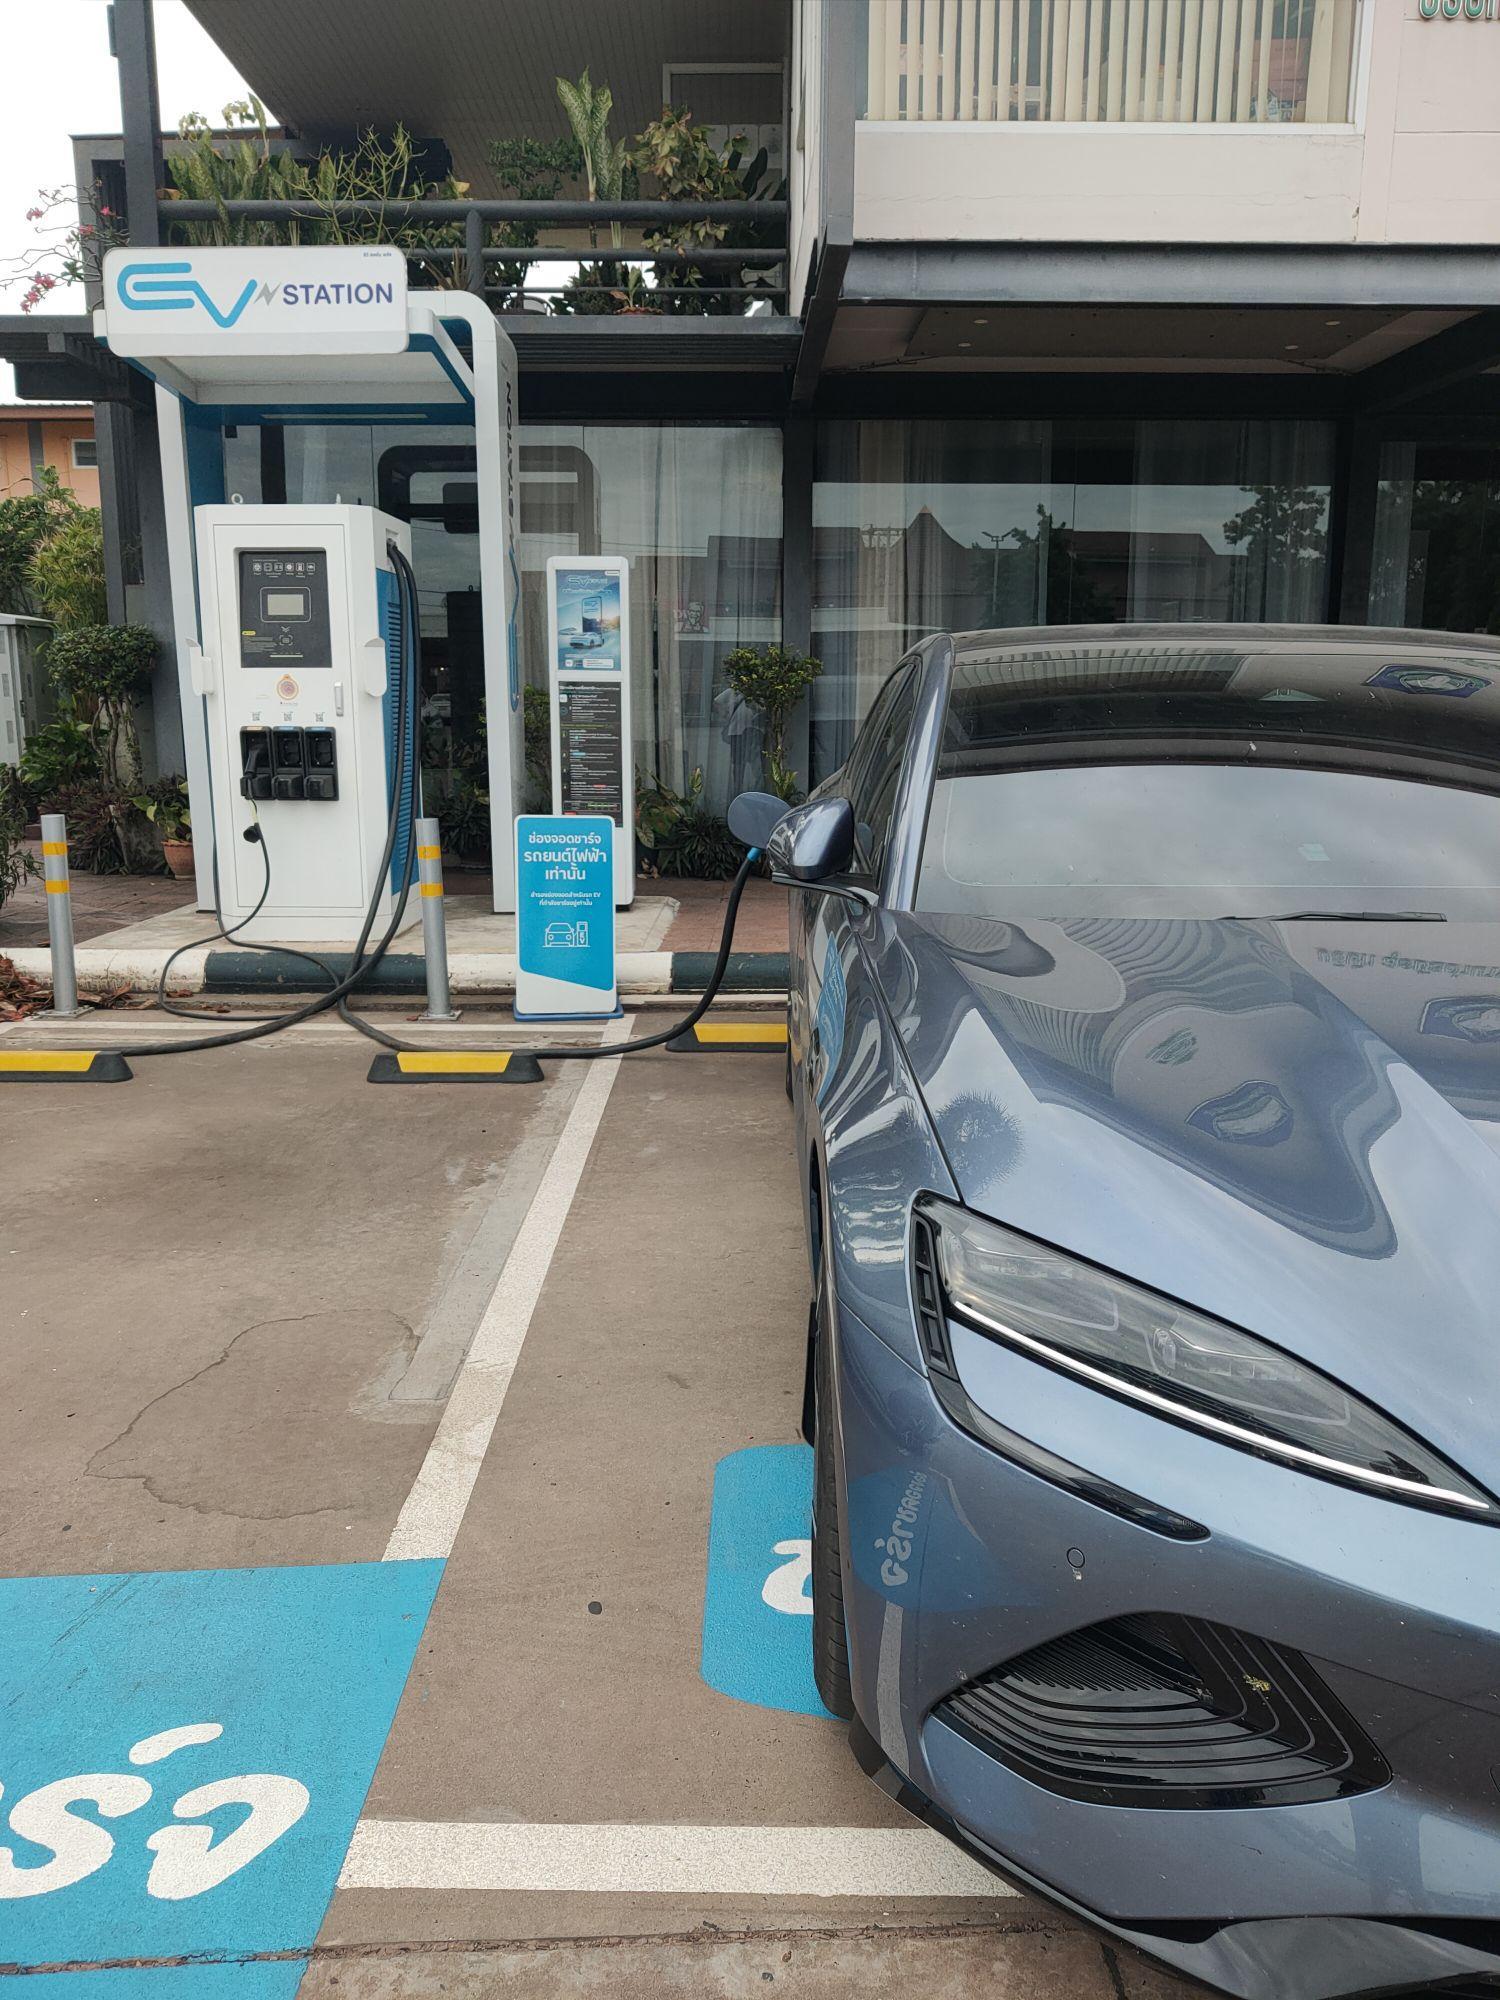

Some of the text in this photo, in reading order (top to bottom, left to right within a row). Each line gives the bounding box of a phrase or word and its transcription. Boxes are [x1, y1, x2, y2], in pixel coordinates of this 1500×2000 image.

[117, 262, 392, 328] EV STATION
[505, 381, 514, 518] STATION
[524, 847, 607, 863] รถยนต์ไฟฟ้า
[529, 832, 602, 844] ช่องจอดชาร์จ
[545, 862, 586, 880] เท่านั้น
[0, 1722, 310, 1900] ร์จ
